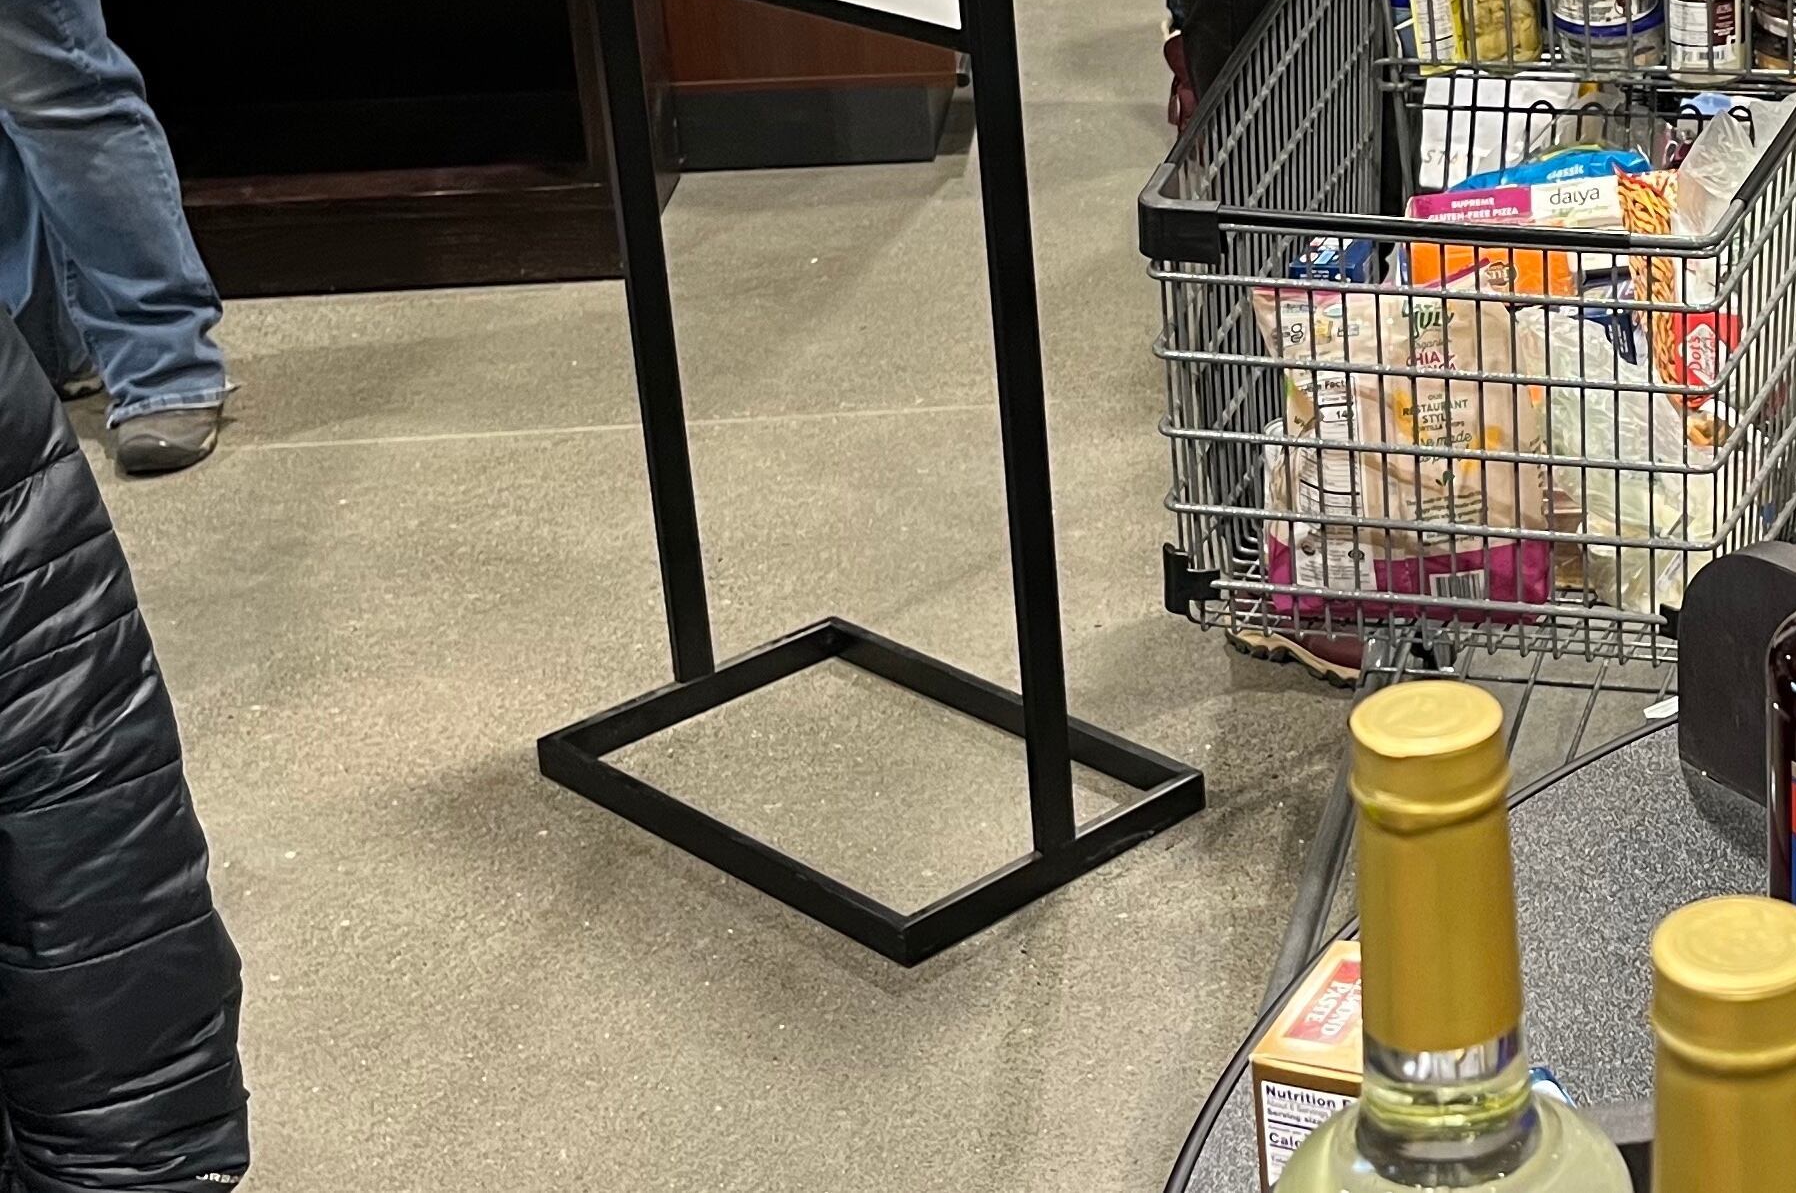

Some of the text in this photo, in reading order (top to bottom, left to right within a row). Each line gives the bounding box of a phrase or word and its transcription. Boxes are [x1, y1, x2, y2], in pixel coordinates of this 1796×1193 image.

[1451, 197, 1495, 208] SUPREME
[1549, 187, 1600, 206] daiya
[1428, 207, 1519, 221] GLUTEN-FREE PIZZA
[1422, 414, 1452, 424] STYL
[1304, 981, 1345, 1024] PASTE
[1265, 1084, 1336, 1109] Nutrition
